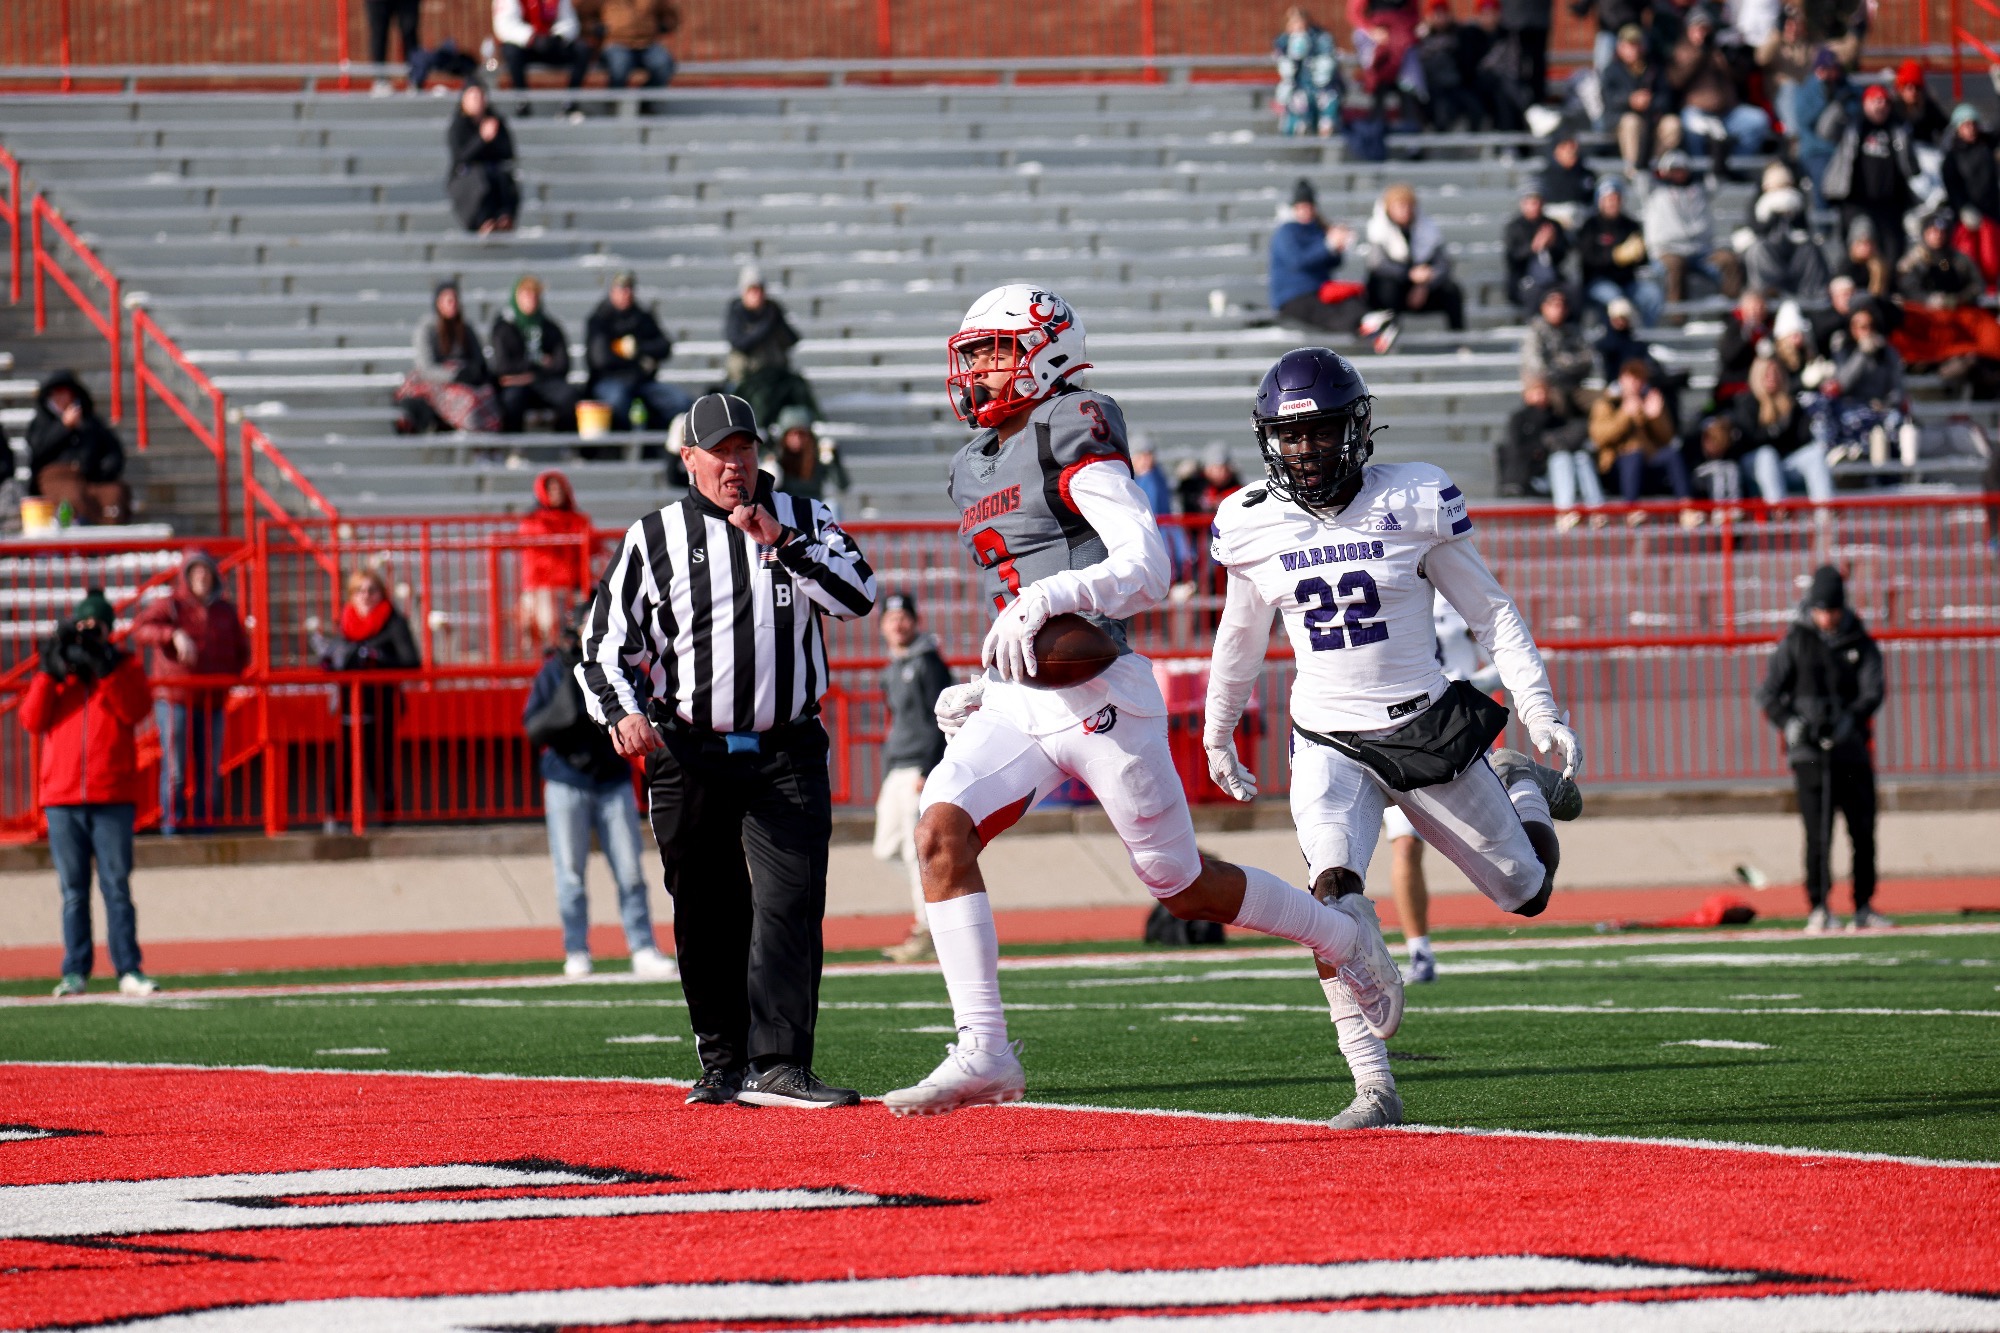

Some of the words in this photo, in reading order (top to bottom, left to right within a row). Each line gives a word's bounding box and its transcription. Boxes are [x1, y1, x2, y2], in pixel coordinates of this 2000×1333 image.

[1079, 399, 1111, 443] 3
[1282, 400, 1312, 411] Riddell
[961, 483, 1022, 535] DRAGONS
[692, 548, 705, 563] S
[972, 526, 1022, 613] 3
[1279, 540, 1385, 572] WARRIORS
[775, 583, 792, 607] B
[1294, 569, 1390, 652] 22
